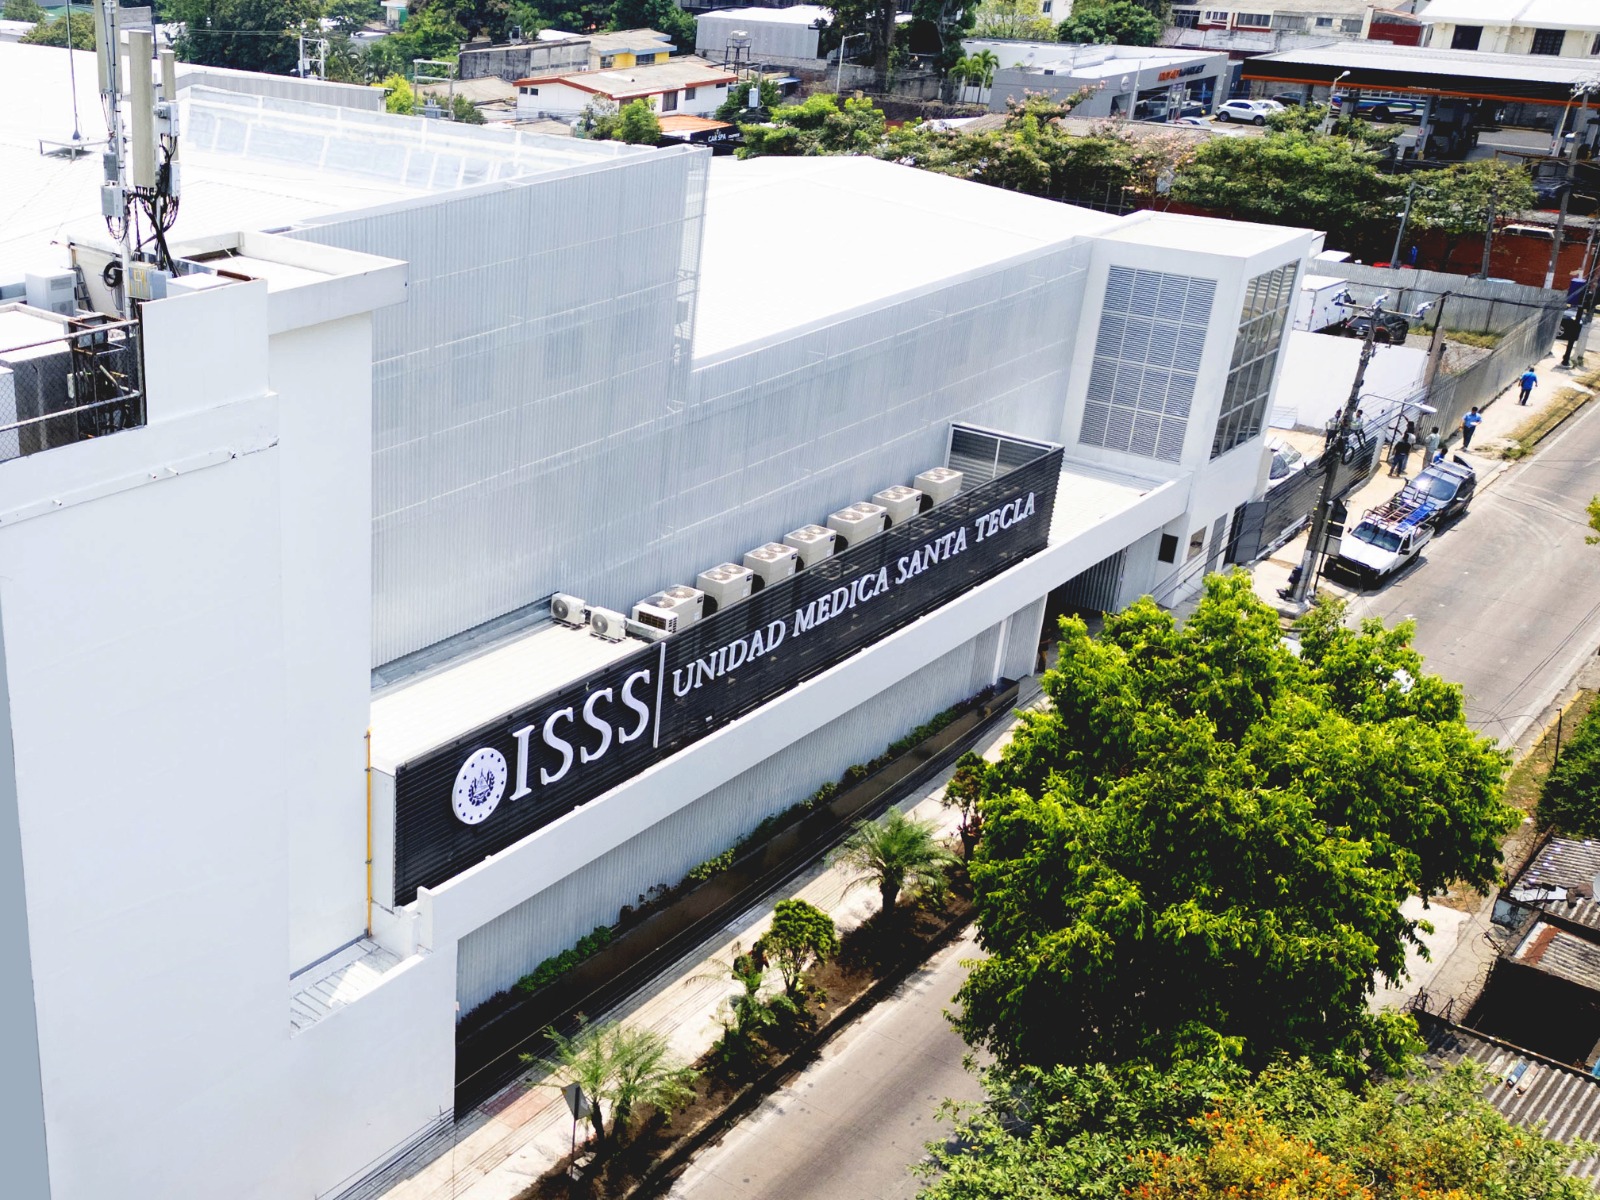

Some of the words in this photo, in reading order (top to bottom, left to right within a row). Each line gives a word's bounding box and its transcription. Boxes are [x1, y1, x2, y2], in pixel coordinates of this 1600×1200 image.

[672, 620, 786, 697] UNIDAD
[792, 566, 890, 638] MEDICA
[895, 526, 968, 585] SANTA
[974, 491, 1036, 543] TECLA
[509, 669, 651, 801] ISSS
